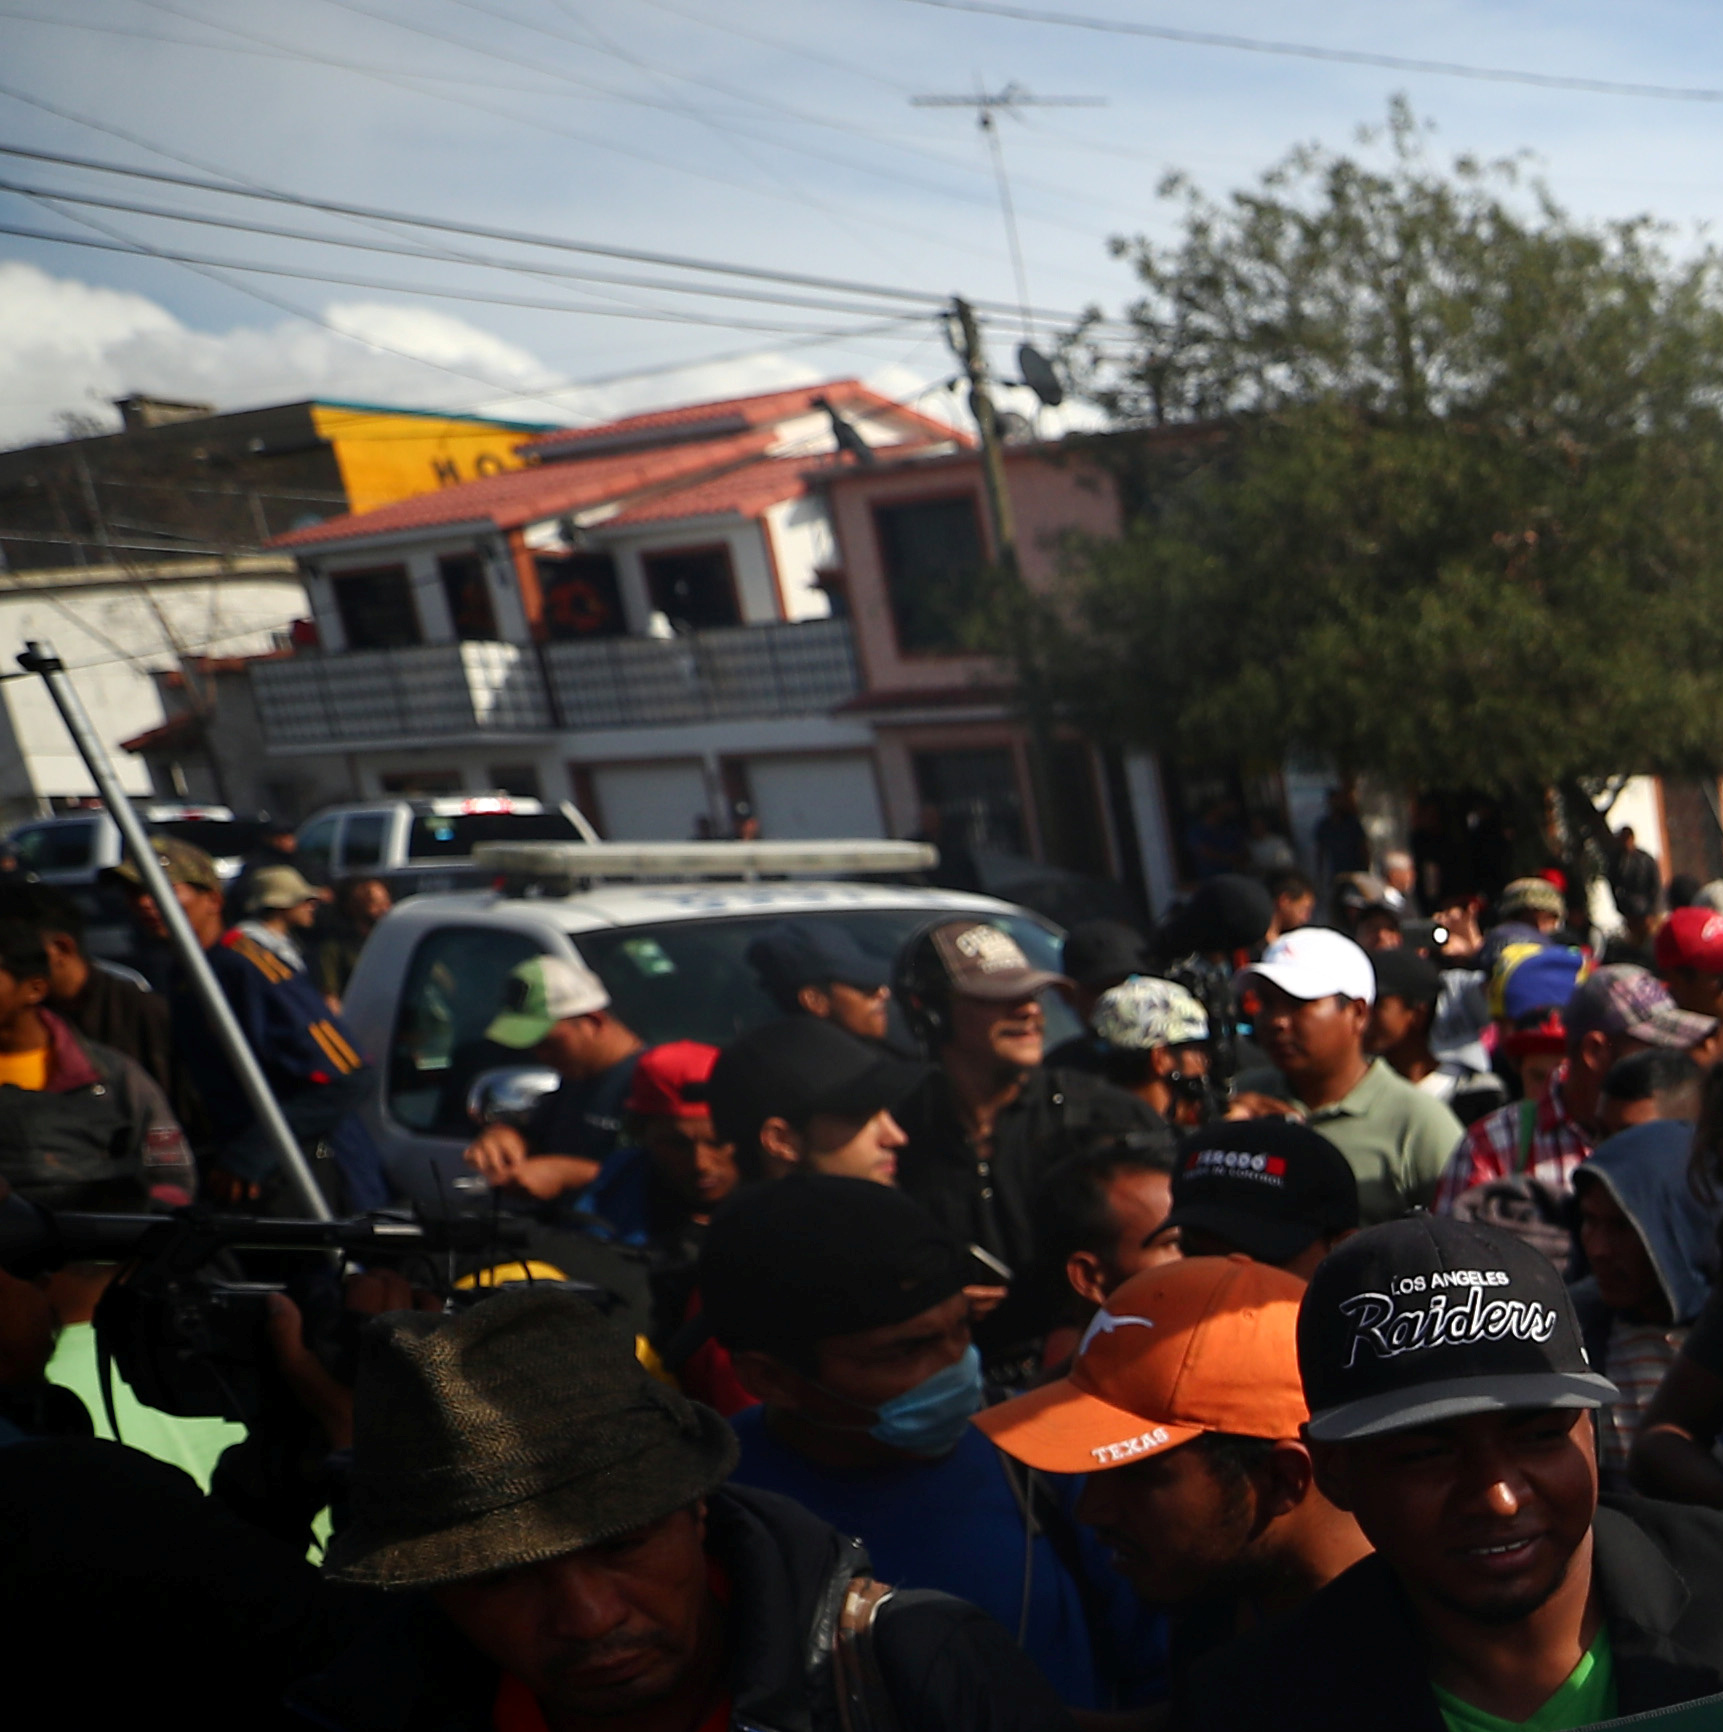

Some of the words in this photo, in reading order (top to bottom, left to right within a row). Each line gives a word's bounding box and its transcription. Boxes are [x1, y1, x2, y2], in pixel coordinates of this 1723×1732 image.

[1390, 1274, 1428, 1297] LOS
[1430, 1269, 1511, 1291] ANGELES
[1339, 1286, 1557, 1369] Raiders
[1090, 1426, 1171, 1464] TEXAS
